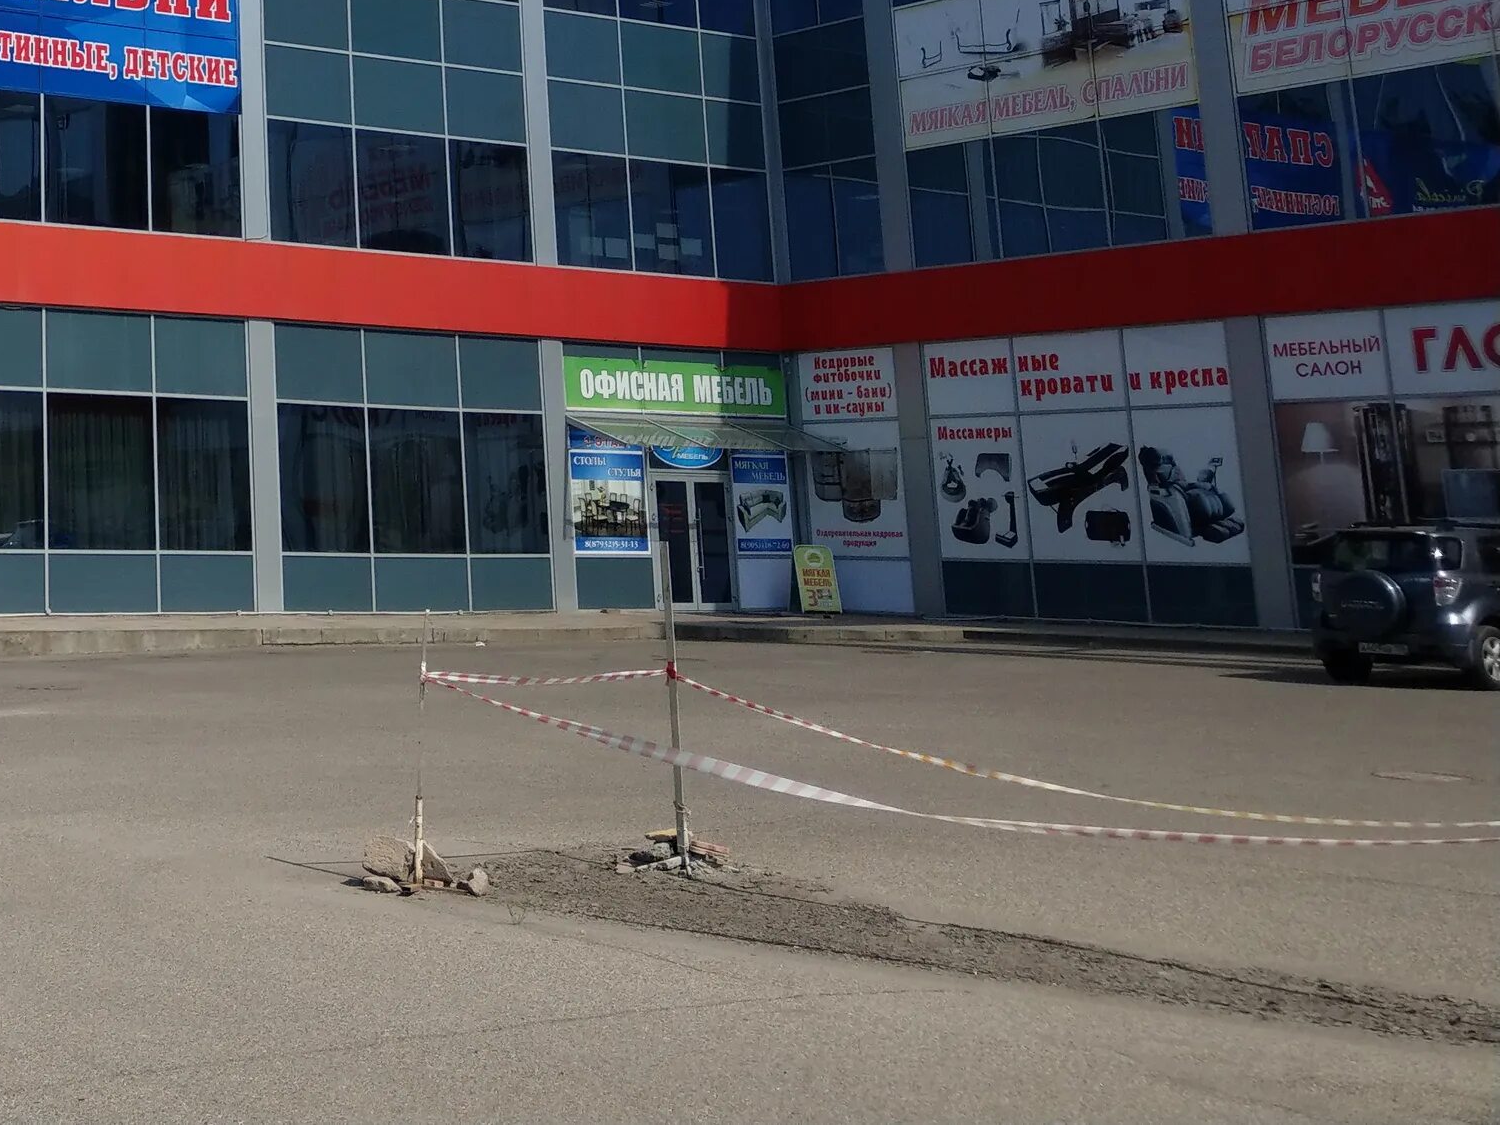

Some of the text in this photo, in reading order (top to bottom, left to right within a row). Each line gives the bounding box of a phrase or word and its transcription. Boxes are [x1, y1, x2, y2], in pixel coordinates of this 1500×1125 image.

[123, 45, 238, 88] ДЕТСКИЕ
[910, 62, 1189, 136] МЯГКАЯ МЕБЕЛЬ, СПАЛЬНИ
[1273, 335, 1380, 358] МЕБЕЛЬНЫЙ
[814, 355, 874, 371] Кедровые
[1296, 360, 1362, 377] САЛОН
[579, 368, 773, 405] ОФИСНАЯ МЕБЕЛЬ
[1020, 366, 1228, 401] кровати и кресла
[814, 404, 821, 415] и
[937, 425, 1013, 442] Массажеры
[573, 456, 607, 466] СТОЛЫ
[607, 467, 642, 477] СТУЛЬЯ
